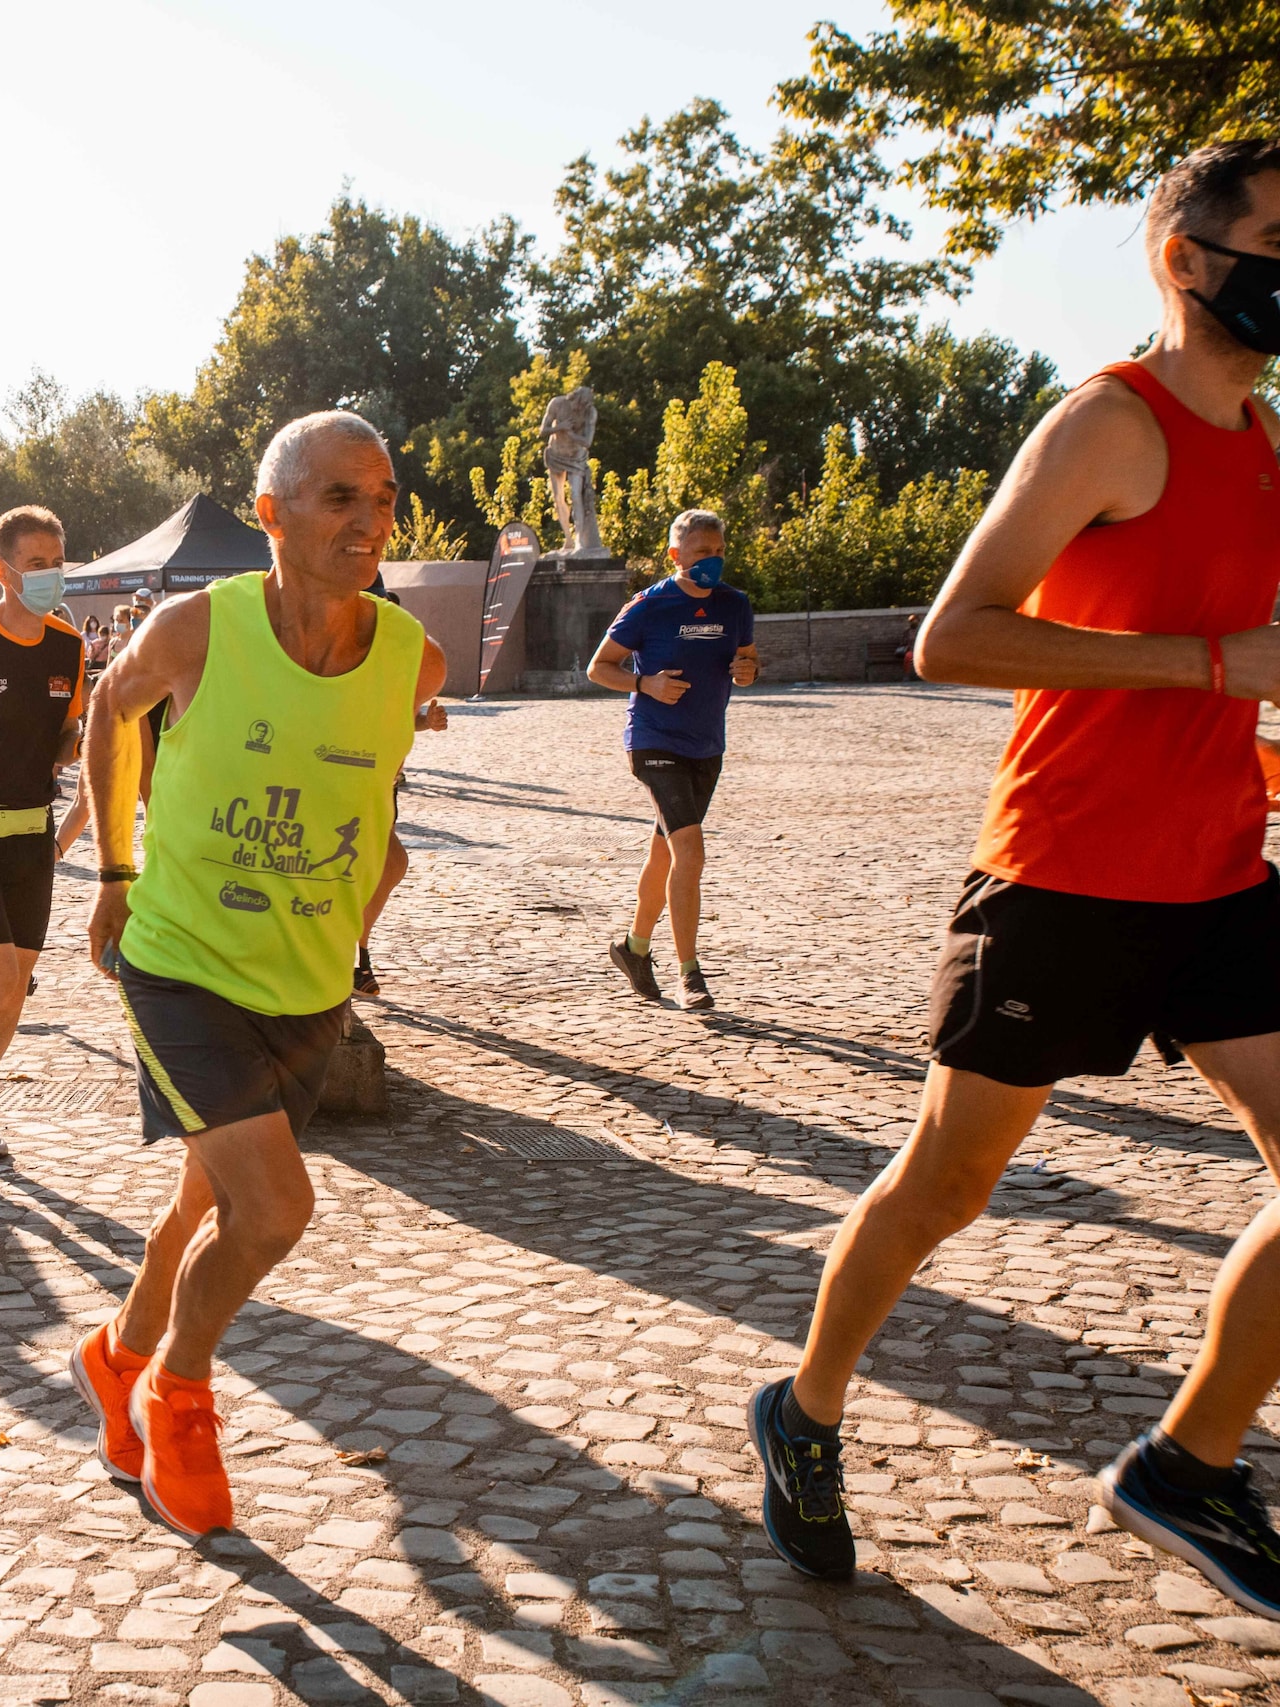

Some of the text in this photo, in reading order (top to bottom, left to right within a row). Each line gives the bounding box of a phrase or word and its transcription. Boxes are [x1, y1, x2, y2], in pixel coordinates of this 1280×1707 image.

[265, 785, 301, 820] 11
[210, 797, 304, 848] la Corsa
[232, 843, 311, 874] dei Santi
[221, 890, 268, 907] Melinda
